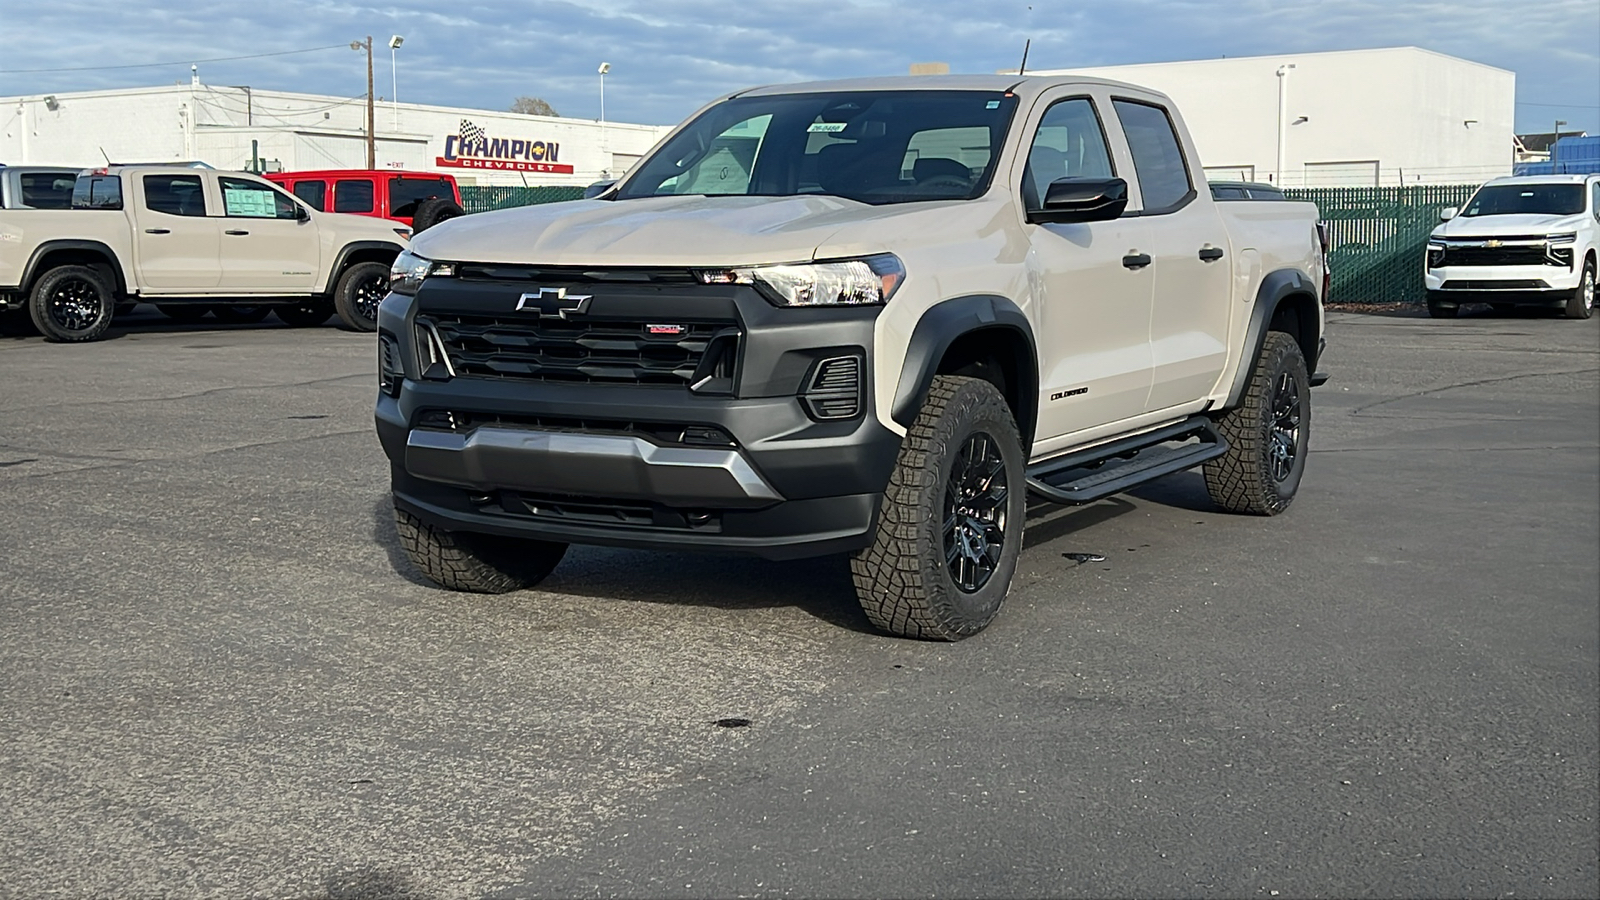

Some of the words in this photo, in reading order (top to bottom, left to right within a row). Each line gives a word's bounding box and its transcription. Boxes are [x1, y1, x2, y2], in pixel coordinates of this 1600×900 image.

[444, 135, 560, 162] CHAMPION
[392, 161, 404, 169] EXIT
[462, 160, 555, 172] CHEVROLET
